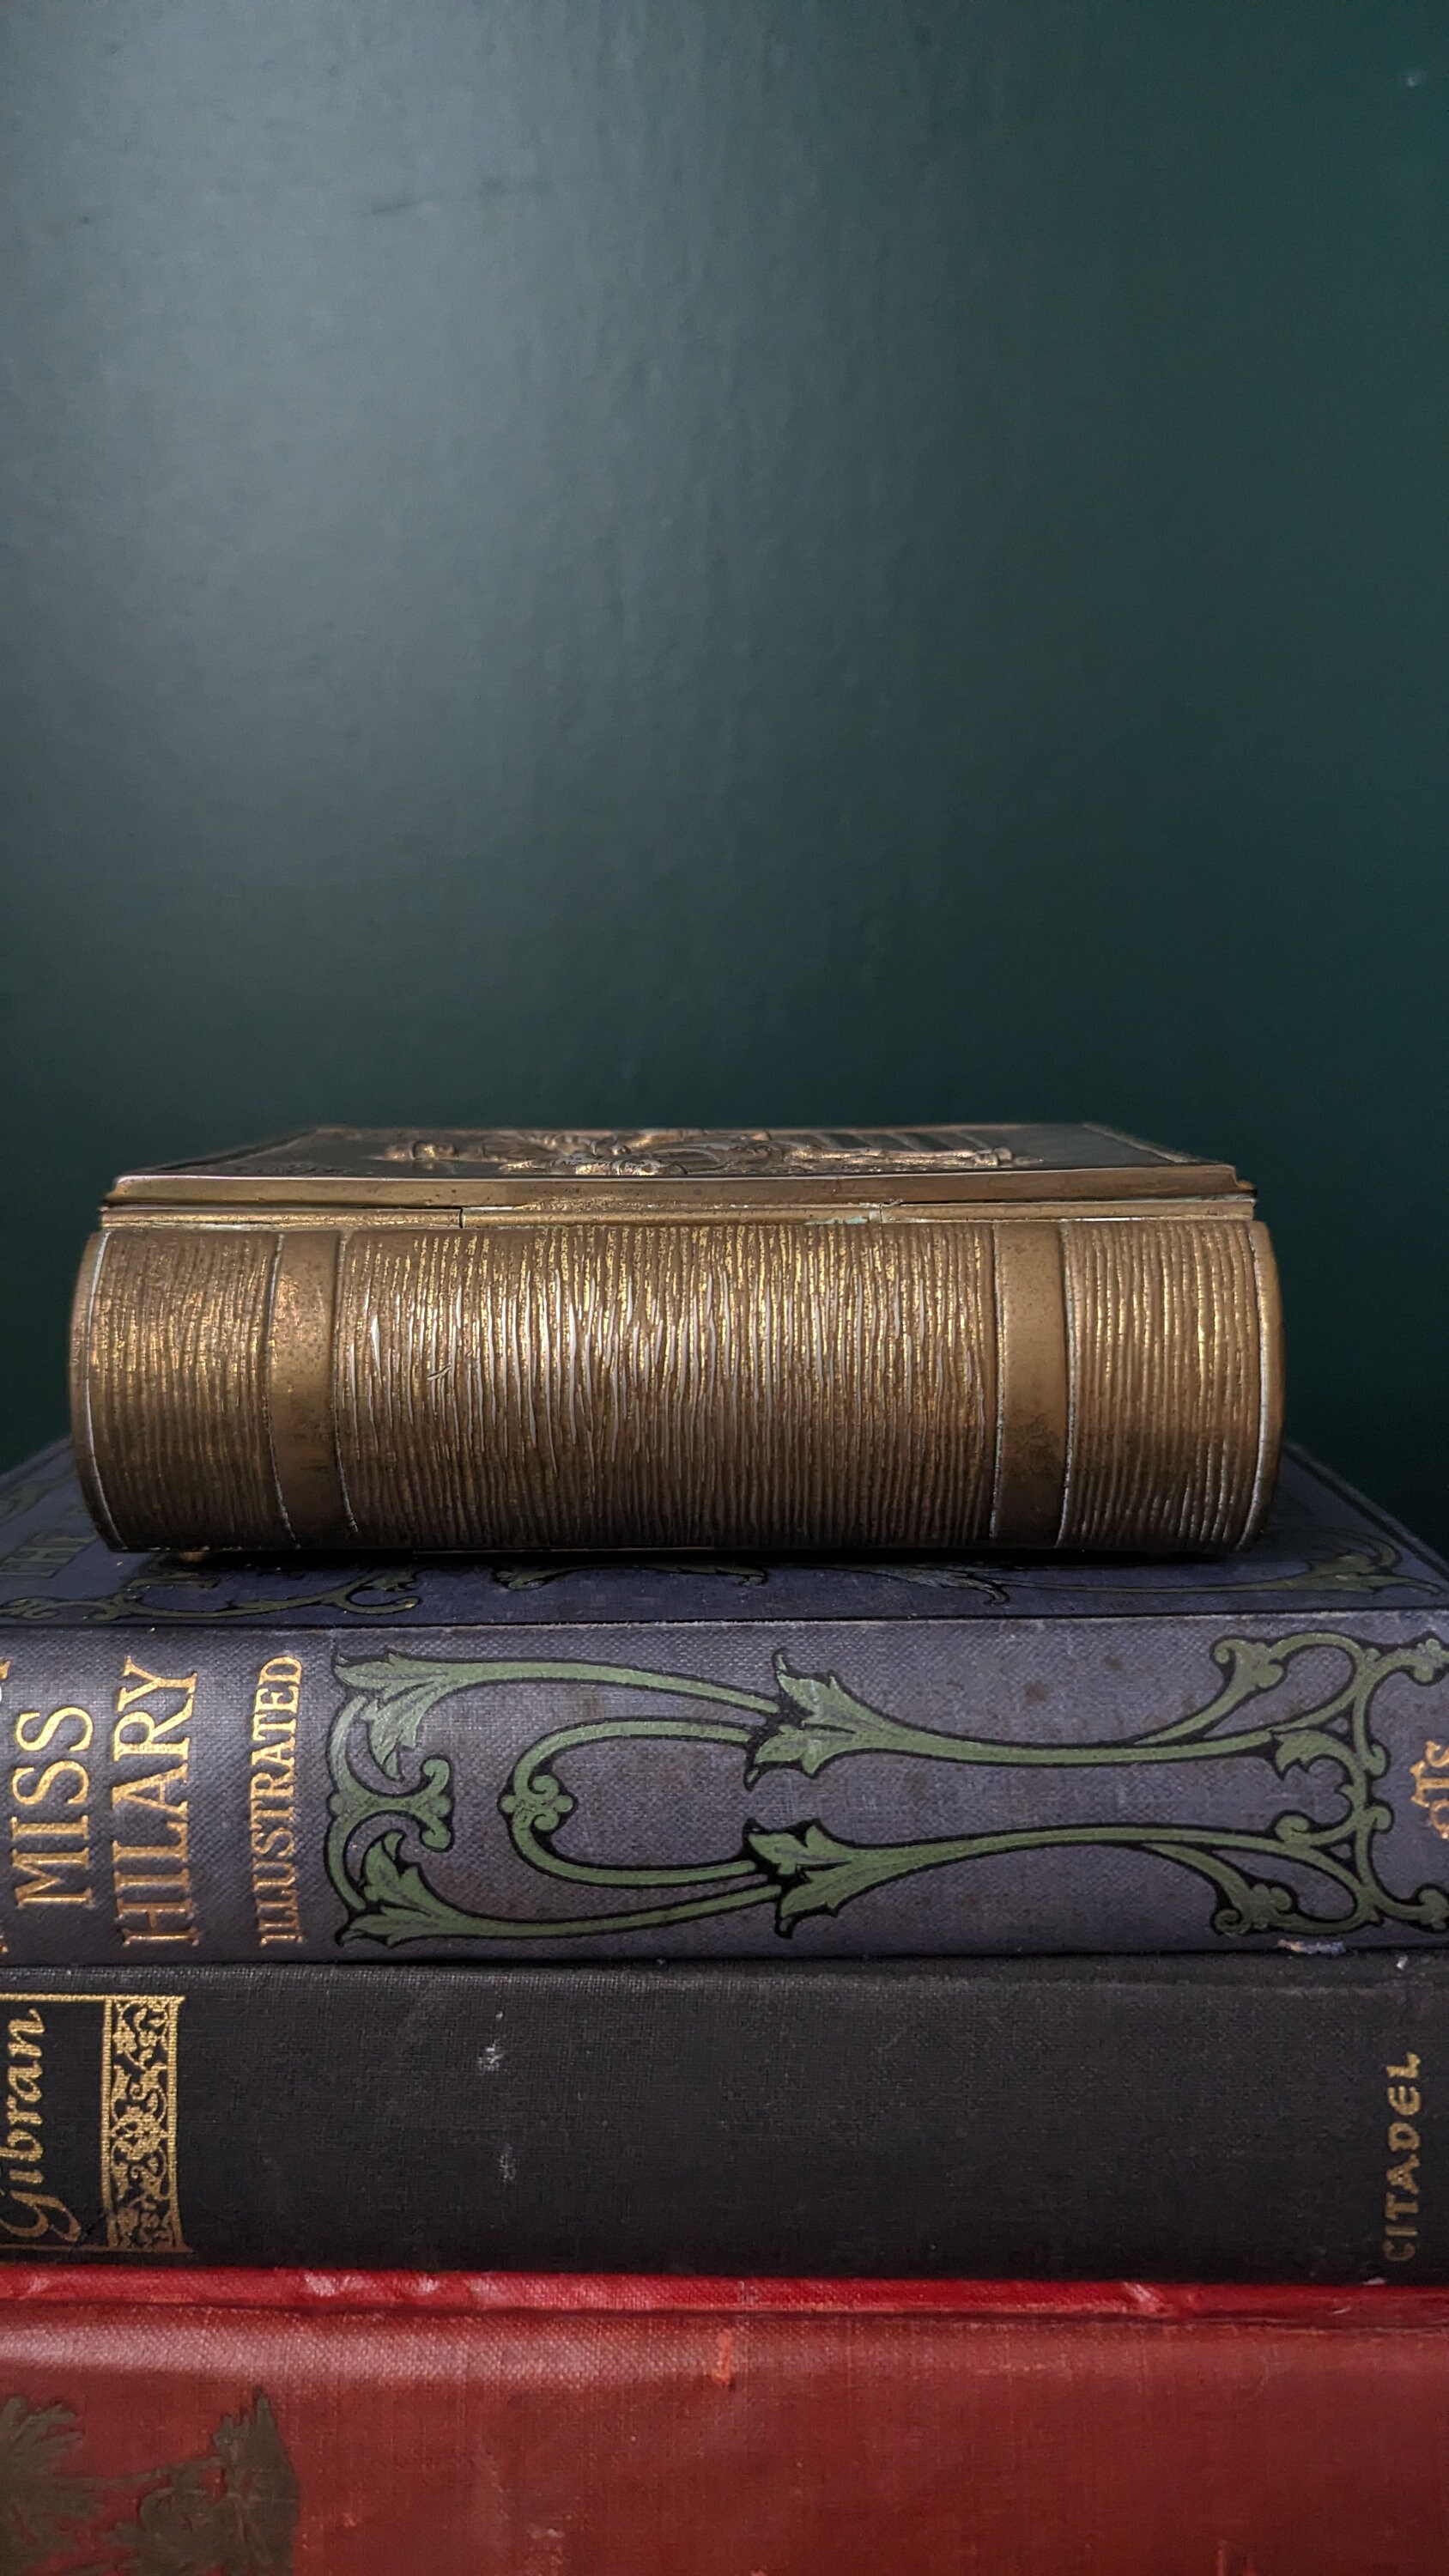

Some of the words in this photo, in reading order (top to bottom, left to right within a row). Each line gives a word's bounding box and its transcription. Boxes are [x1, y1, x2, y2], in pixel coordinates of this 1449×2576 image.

[11, 1706, 94, 1910] MISS
[112, 1656, 199, 1947] HILARY
[249, 1655, 304, 1946] ILLUSTRATED
[1382, 2050, 1421, 2262] CITADEL
